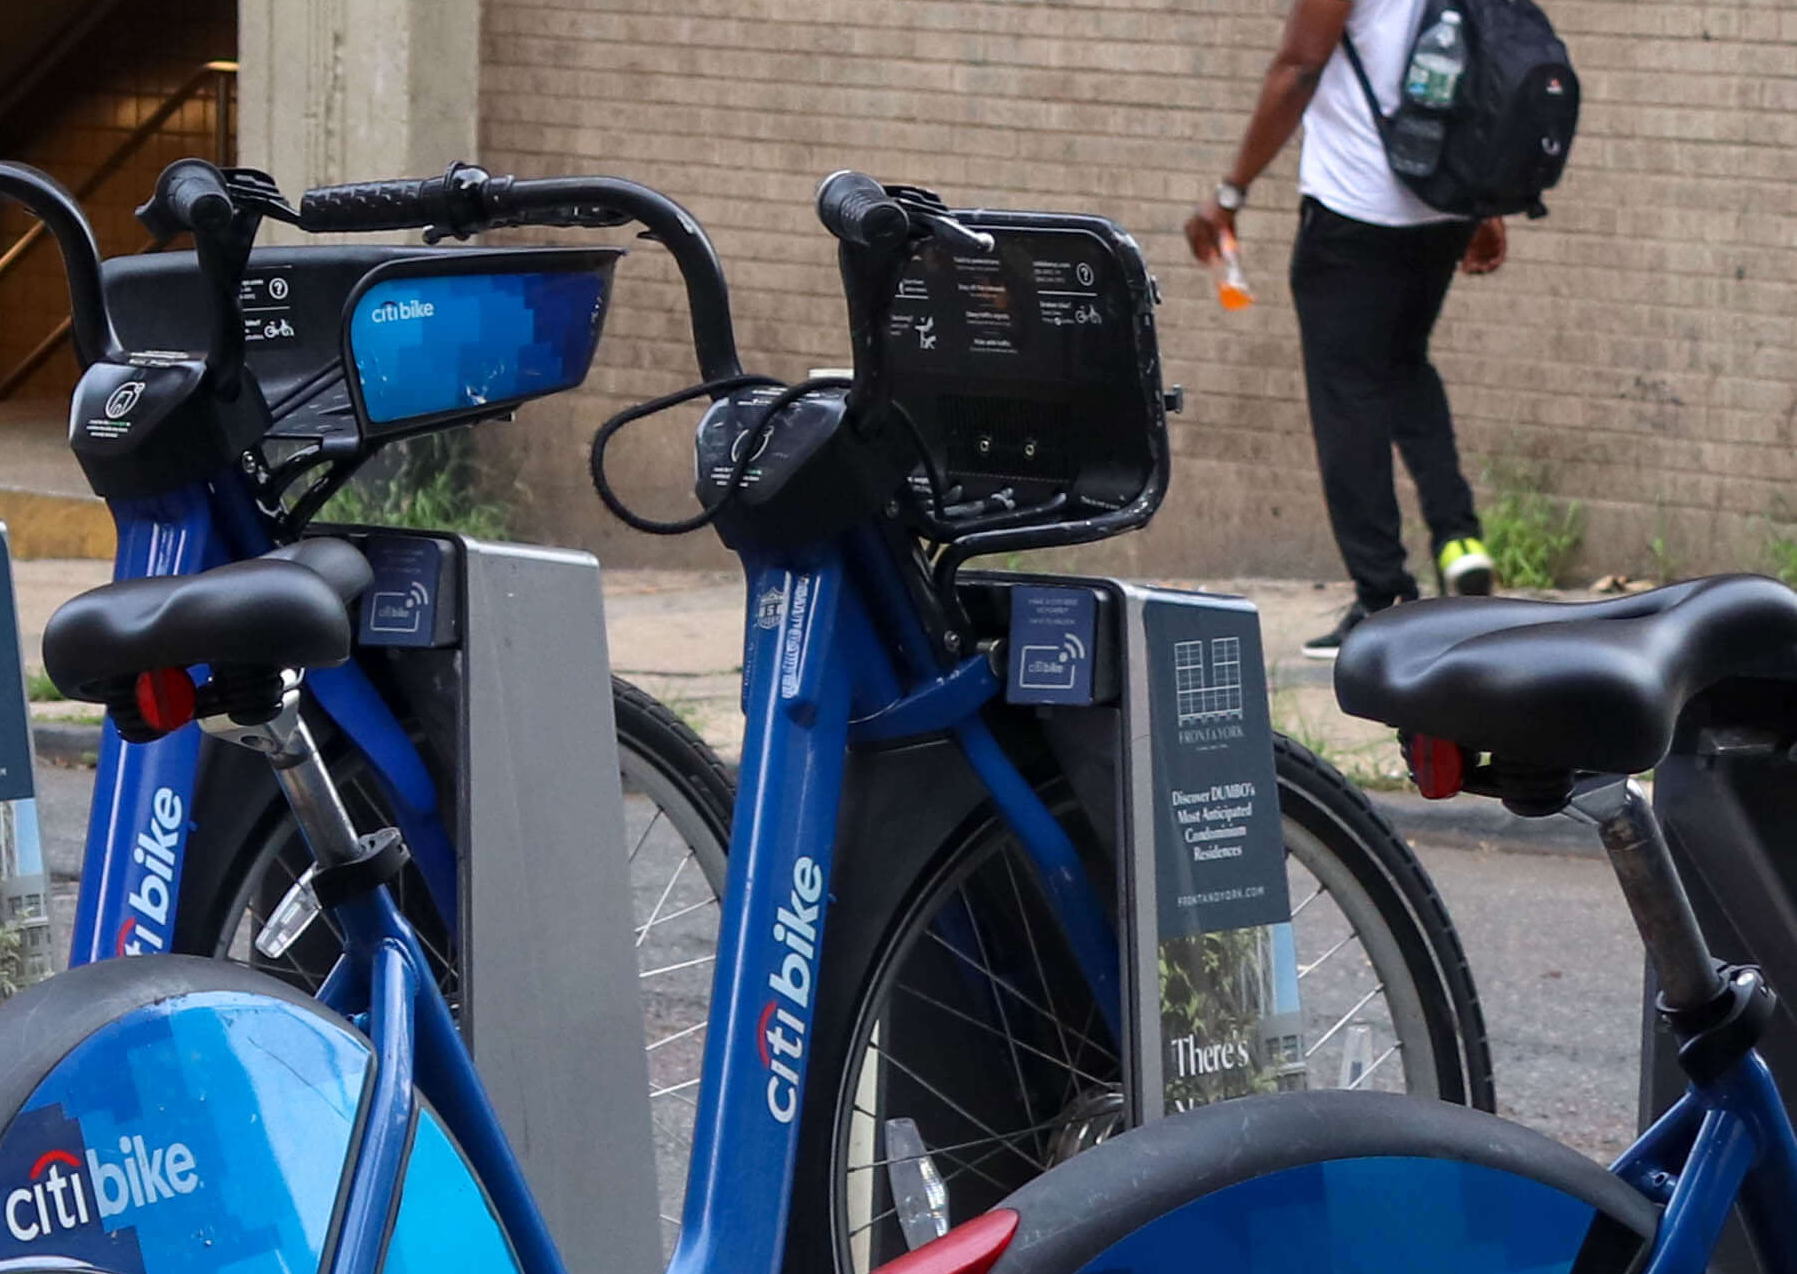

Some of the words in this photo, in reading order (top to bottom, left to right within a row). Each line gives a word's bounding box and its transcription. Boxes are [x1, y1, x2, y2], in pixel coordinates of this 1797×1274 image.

[372, 301, 399, 323] citi
[399, 299, 435, 322] bike
[1172, 790, 1210, 806] Discover
[1210, 782, 1256, 801] DUMBO's
[1177, 810, 1201, 824] Most
[1202, 802, 1253, 823] Anticipated
[128, 786, 183, 926] bike
[1193, 845, 1243, 861] Residences
[768, 855, 823, 1010] bike
[757, 1000, 807, 1124] citi
[1170, 1031, 1250, 1079] There's
[6, 1149, 89, 1243] citi
[87, 1133, 201, 1219] bike
